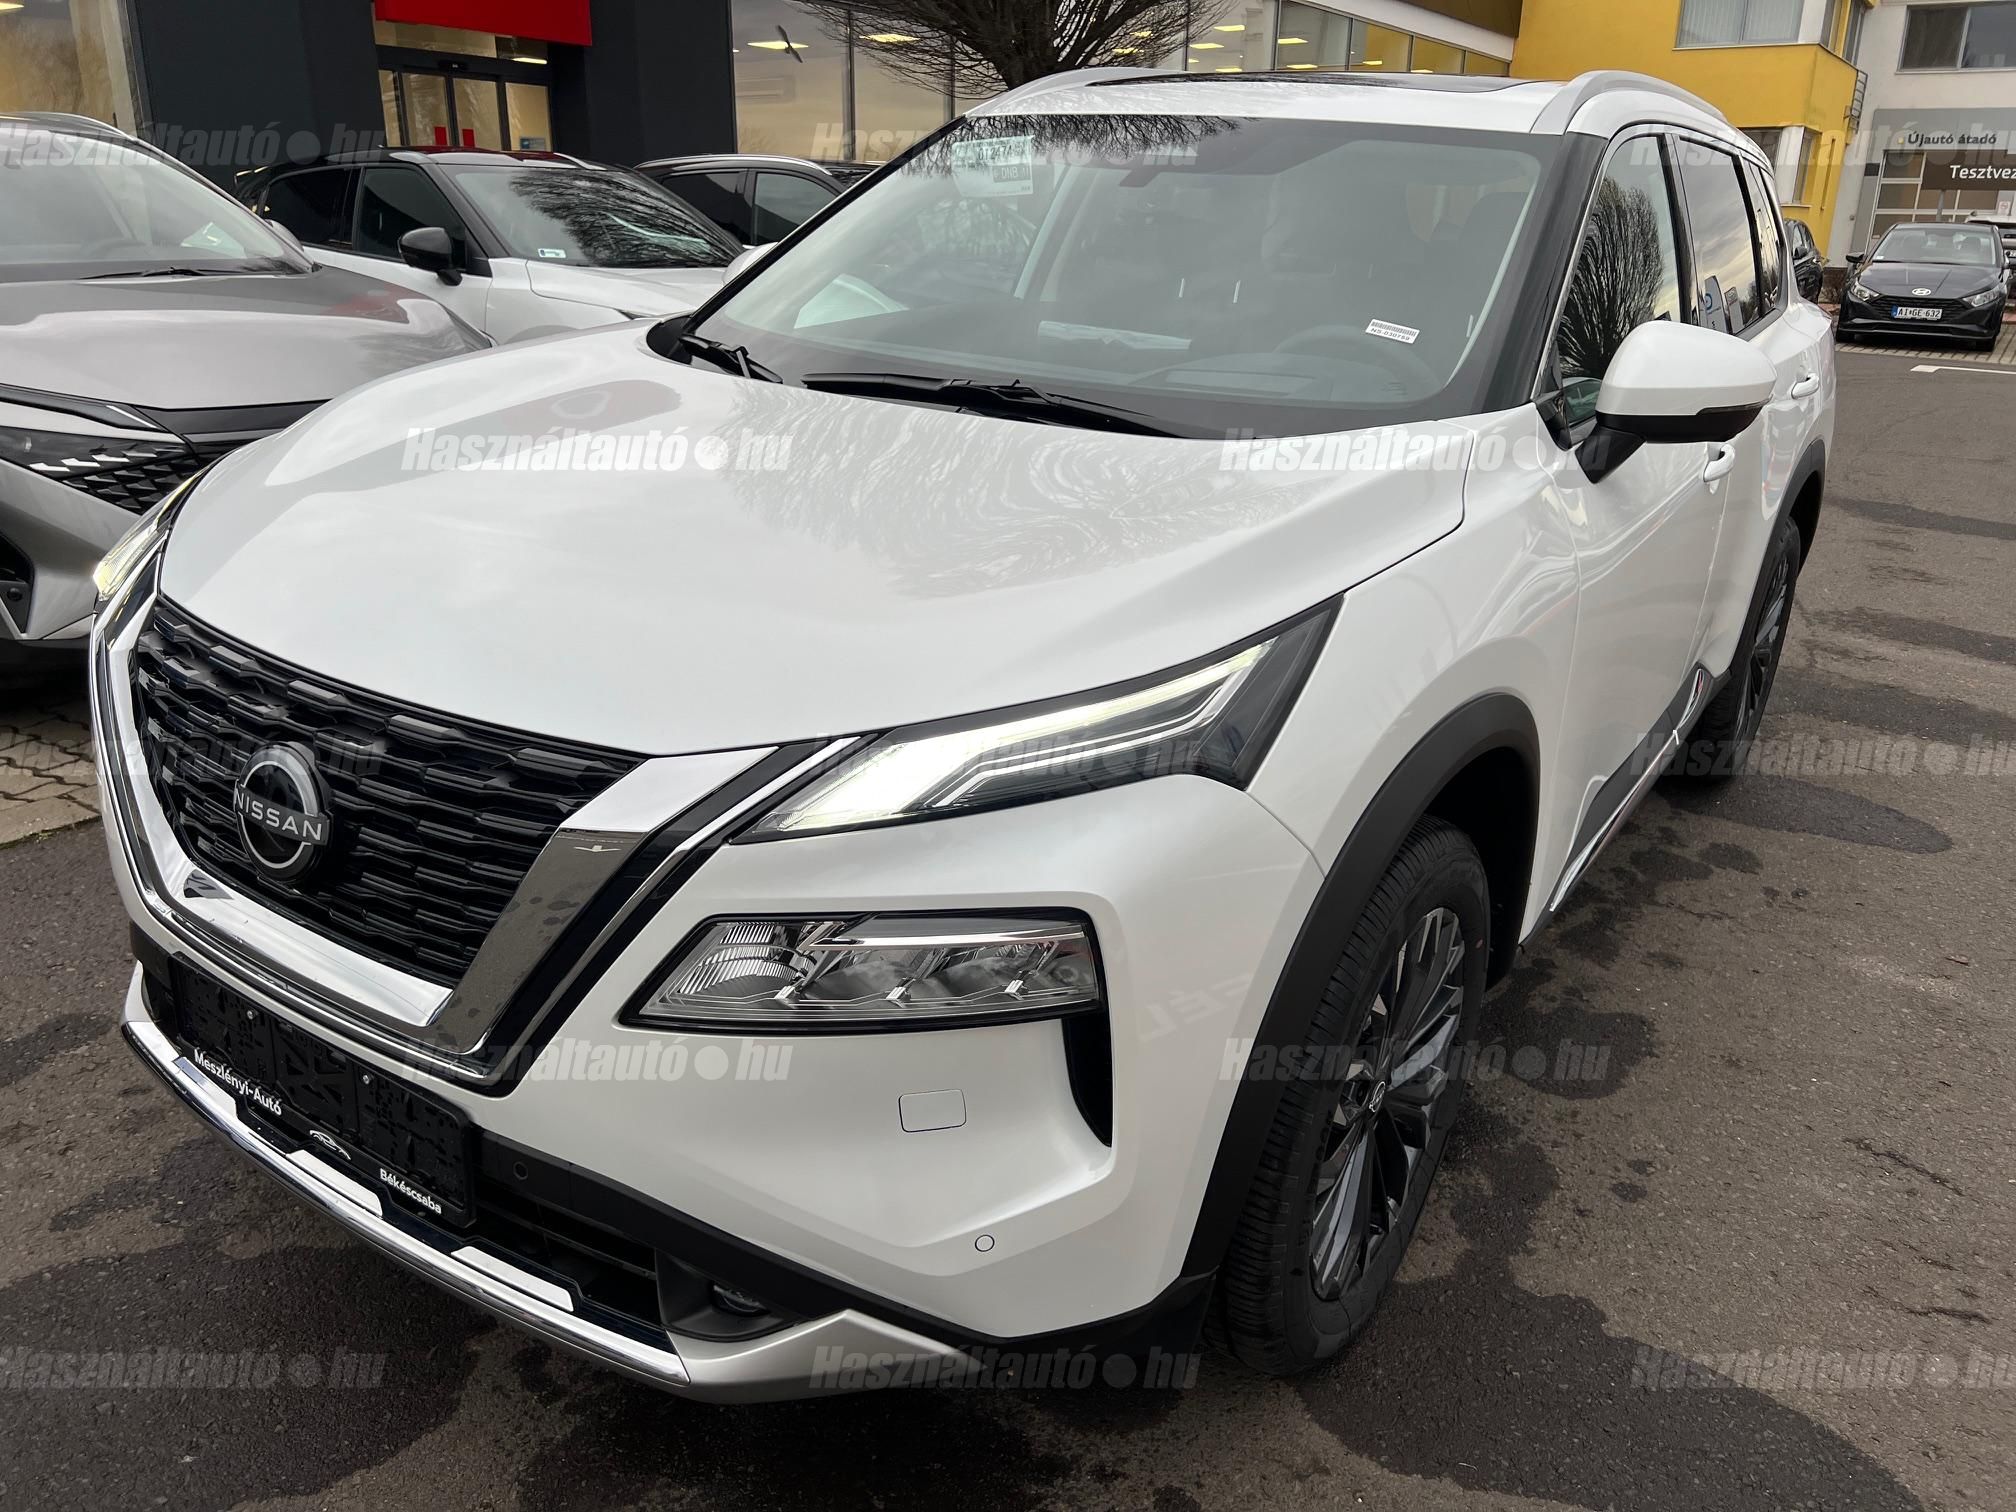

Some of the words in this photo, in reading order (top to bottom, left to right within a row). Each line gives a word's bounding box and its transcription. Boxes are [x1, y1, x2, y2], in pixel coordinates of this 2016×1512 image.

[1908, 131, 1954, 147] Újautó
[1958, 134, 1997, 144] átadó
[233, 788, 322, 840] NISSAN
[194, 1048, 282, 1116] Meszlényi-Autó
[380, 1168, 442, 1215] Békéscsaba
